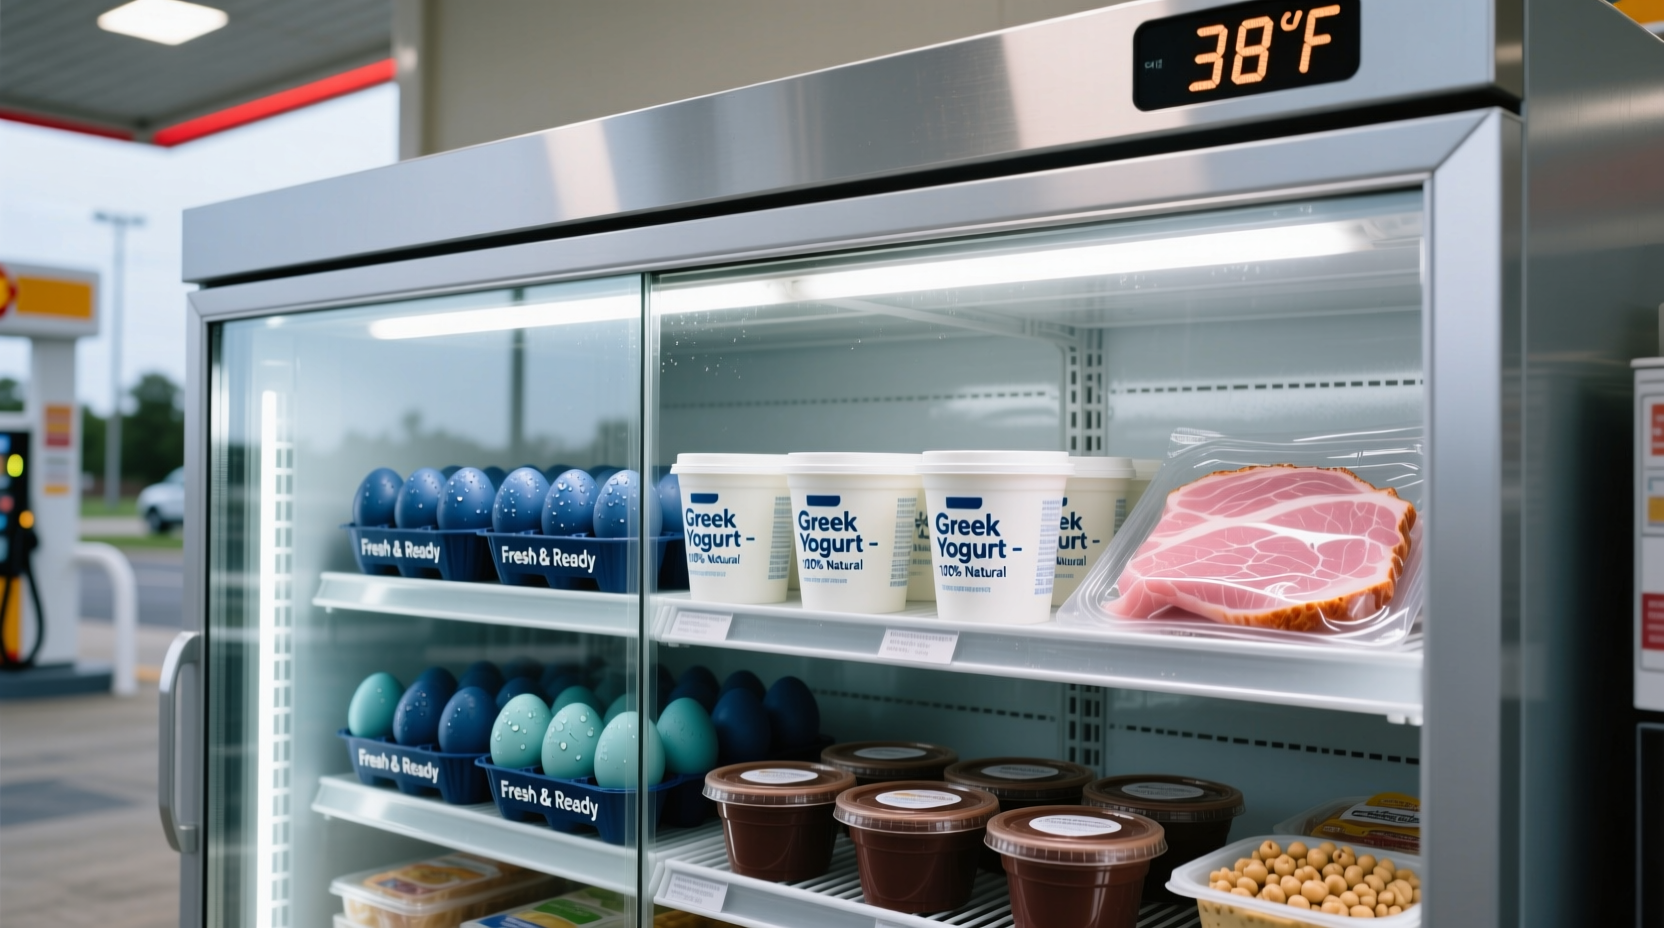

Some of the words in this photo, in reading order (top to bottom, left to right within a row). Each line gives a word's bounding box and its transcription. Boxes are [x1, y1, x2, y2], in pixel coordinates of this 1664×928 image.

[1188, 4, 1341, 92] 38°F
[686, 508, 737, 529] Greek
[798, 510, 858, 533] Greek
[936, 512, 1001, 537] Greek
[361, 538, 391, 557] Fresh
[392, 540, 402, 557] &
[404, 541, 440, 563] Ready
[687, 530, 741, 552] Yogurt
[800, 533, 863, 558] Yogurt
[937, 537, 1007, 564] Yogurt
[501, 546, 537, 565] Fresh
[539, 548, 551, 566] &
[553, 548, 596, 574] Ready
[826, 559, 863, 570] Natural
[939, 564, 962, 577] 100%
[965, 566, 1006, 578] Natural
[359, 748, 389, 770] Fresh
[390, 755, 400, 773] &
[402, 757, 439, 783] Ready
[501, 780, 537, 804] Fresh
[540, 787, 552, 807] &
[554, 791, 598, 821] Ready
